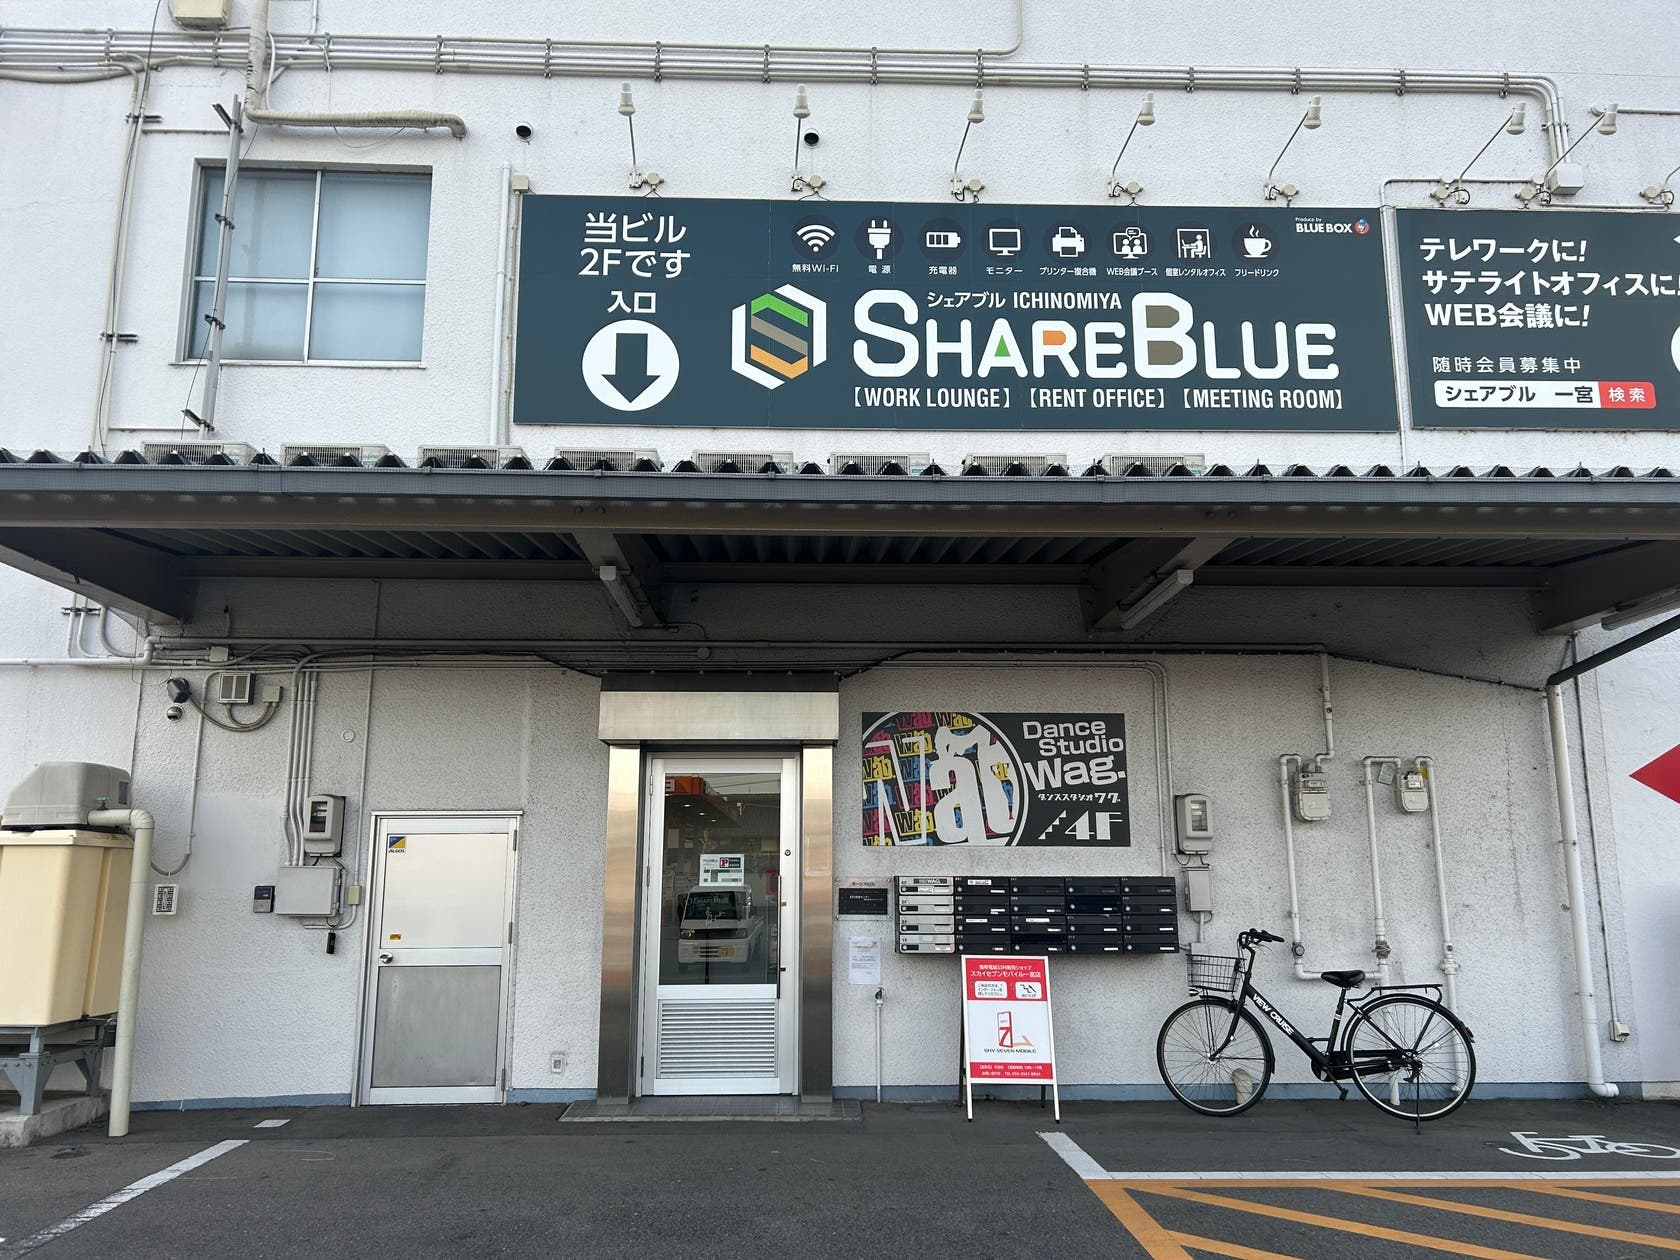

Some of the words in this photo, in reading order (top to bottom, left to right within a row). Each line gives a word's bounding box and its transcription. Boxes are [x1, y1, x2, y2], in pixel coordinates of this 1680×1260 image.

[585, 212, 686, 243] 当ビル
[1295, 223, 1324, 233] BLUE
[1325, 223, 1353, 233] BOX
[1420, 238, 1587, 263] テレワークに!
[579, 248, 690, 278] 2Fです
[928, 265, 957, 275] 充電器
[986, 266, 1023, 275] モニター
[1234, 268, 1279, 277] フリードリンク
[607, 290, 656, 313] 入口
[927, 291, 1006, 308] シェアブル
[1013, 291, 1122, 310] ICHINOMIYA
[1424, 303, 1590, 328] WEB会議に!
[1432, 356, 1581, 374] 随時会員募集中
[1445, 385, 1536, 402] シェアブル
[1555, 385, 1593, 403] 一宮
[1608, 387, 1646, 402] 検索
[1023, 720, 1106, 739] Dance
[1038, 735, 1124, 756] Studio
[1023, 755, 1127, 791] Wag.
[1064, 810, 1123, 840] 4F
[1253, 993, 1271, 1011] VIEW
[1270, 1011, 1294, 1035] CRUISE
